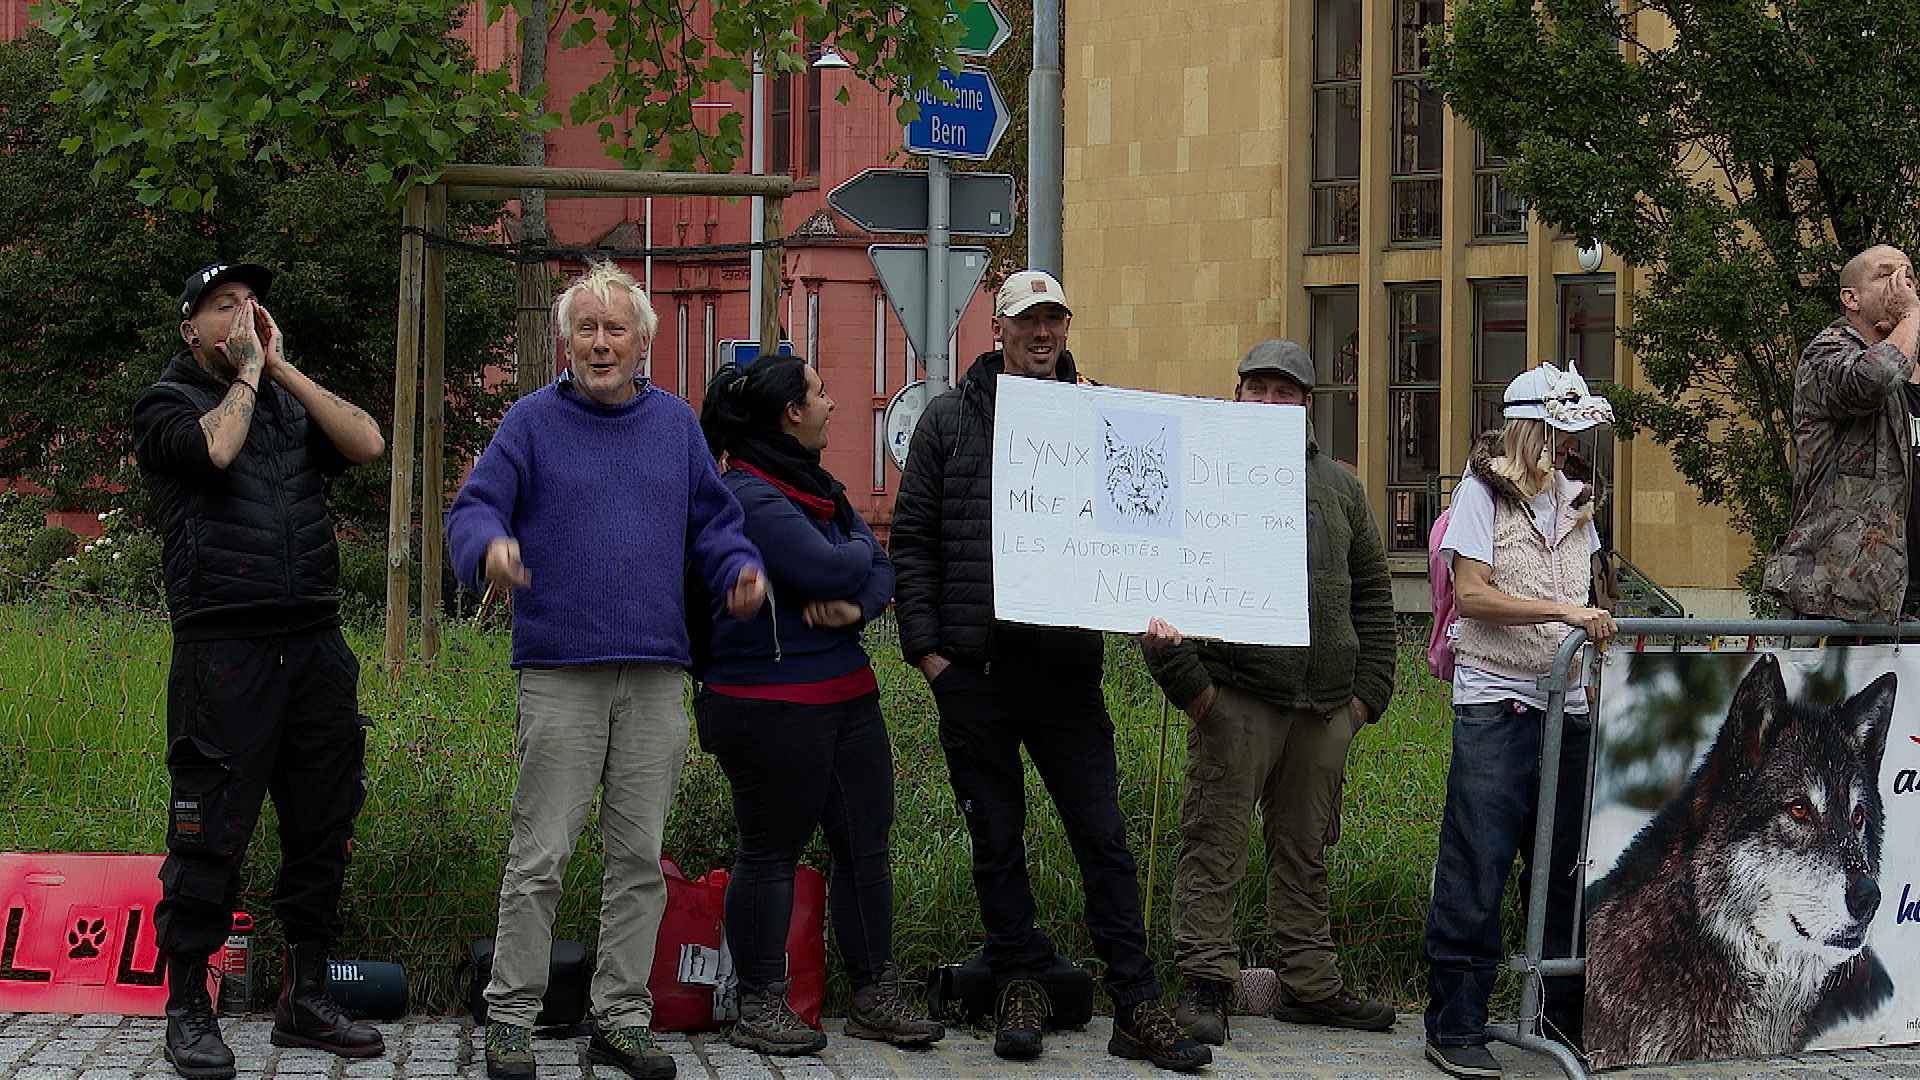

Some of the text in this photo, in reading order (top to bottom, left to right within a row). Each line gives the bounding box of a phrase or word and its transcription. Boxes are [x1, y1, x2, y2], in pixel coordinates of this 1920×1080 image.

[931, 115, 966, 147] Bern
[1187, 453, 1295, 488] DIEGO
[1078, 498, 1094, 521] A
[1184, 508, 1249, 530] MORT
[1260, 513, 1297, 531] PAR
[1001, 530, 1047, 555] LES
[1178, 547, 1214, 566] DE
[1094, 568, 1280, 612] NEUCHÂTEL
[1893, 768, 1920, 796] a
[331, 964, 364, 981] JBL
